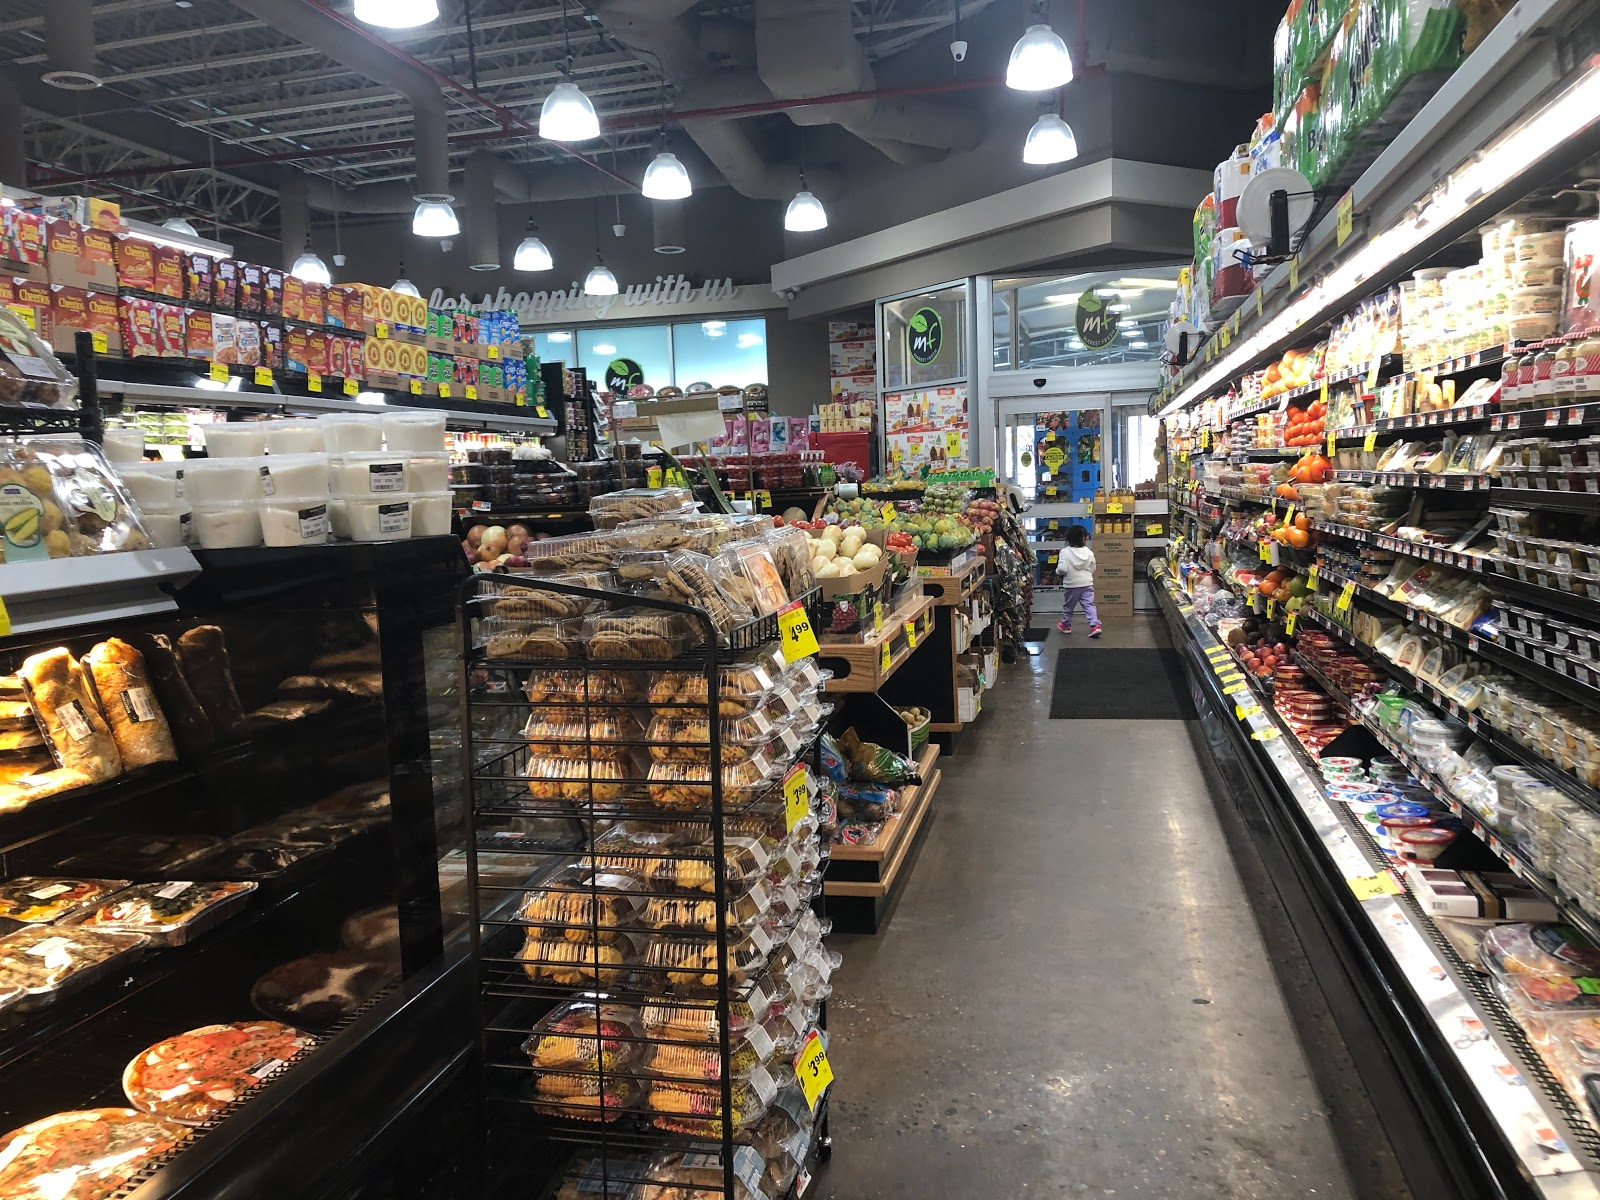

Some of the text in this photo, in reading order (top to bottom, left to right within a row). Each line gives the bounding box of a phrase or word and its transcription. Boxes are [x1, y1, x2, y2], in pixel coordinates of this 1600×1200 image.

[625, 274, 700, 306] with
[702, 277, 739, 301] us
[913, 322, 938, 352] mf
